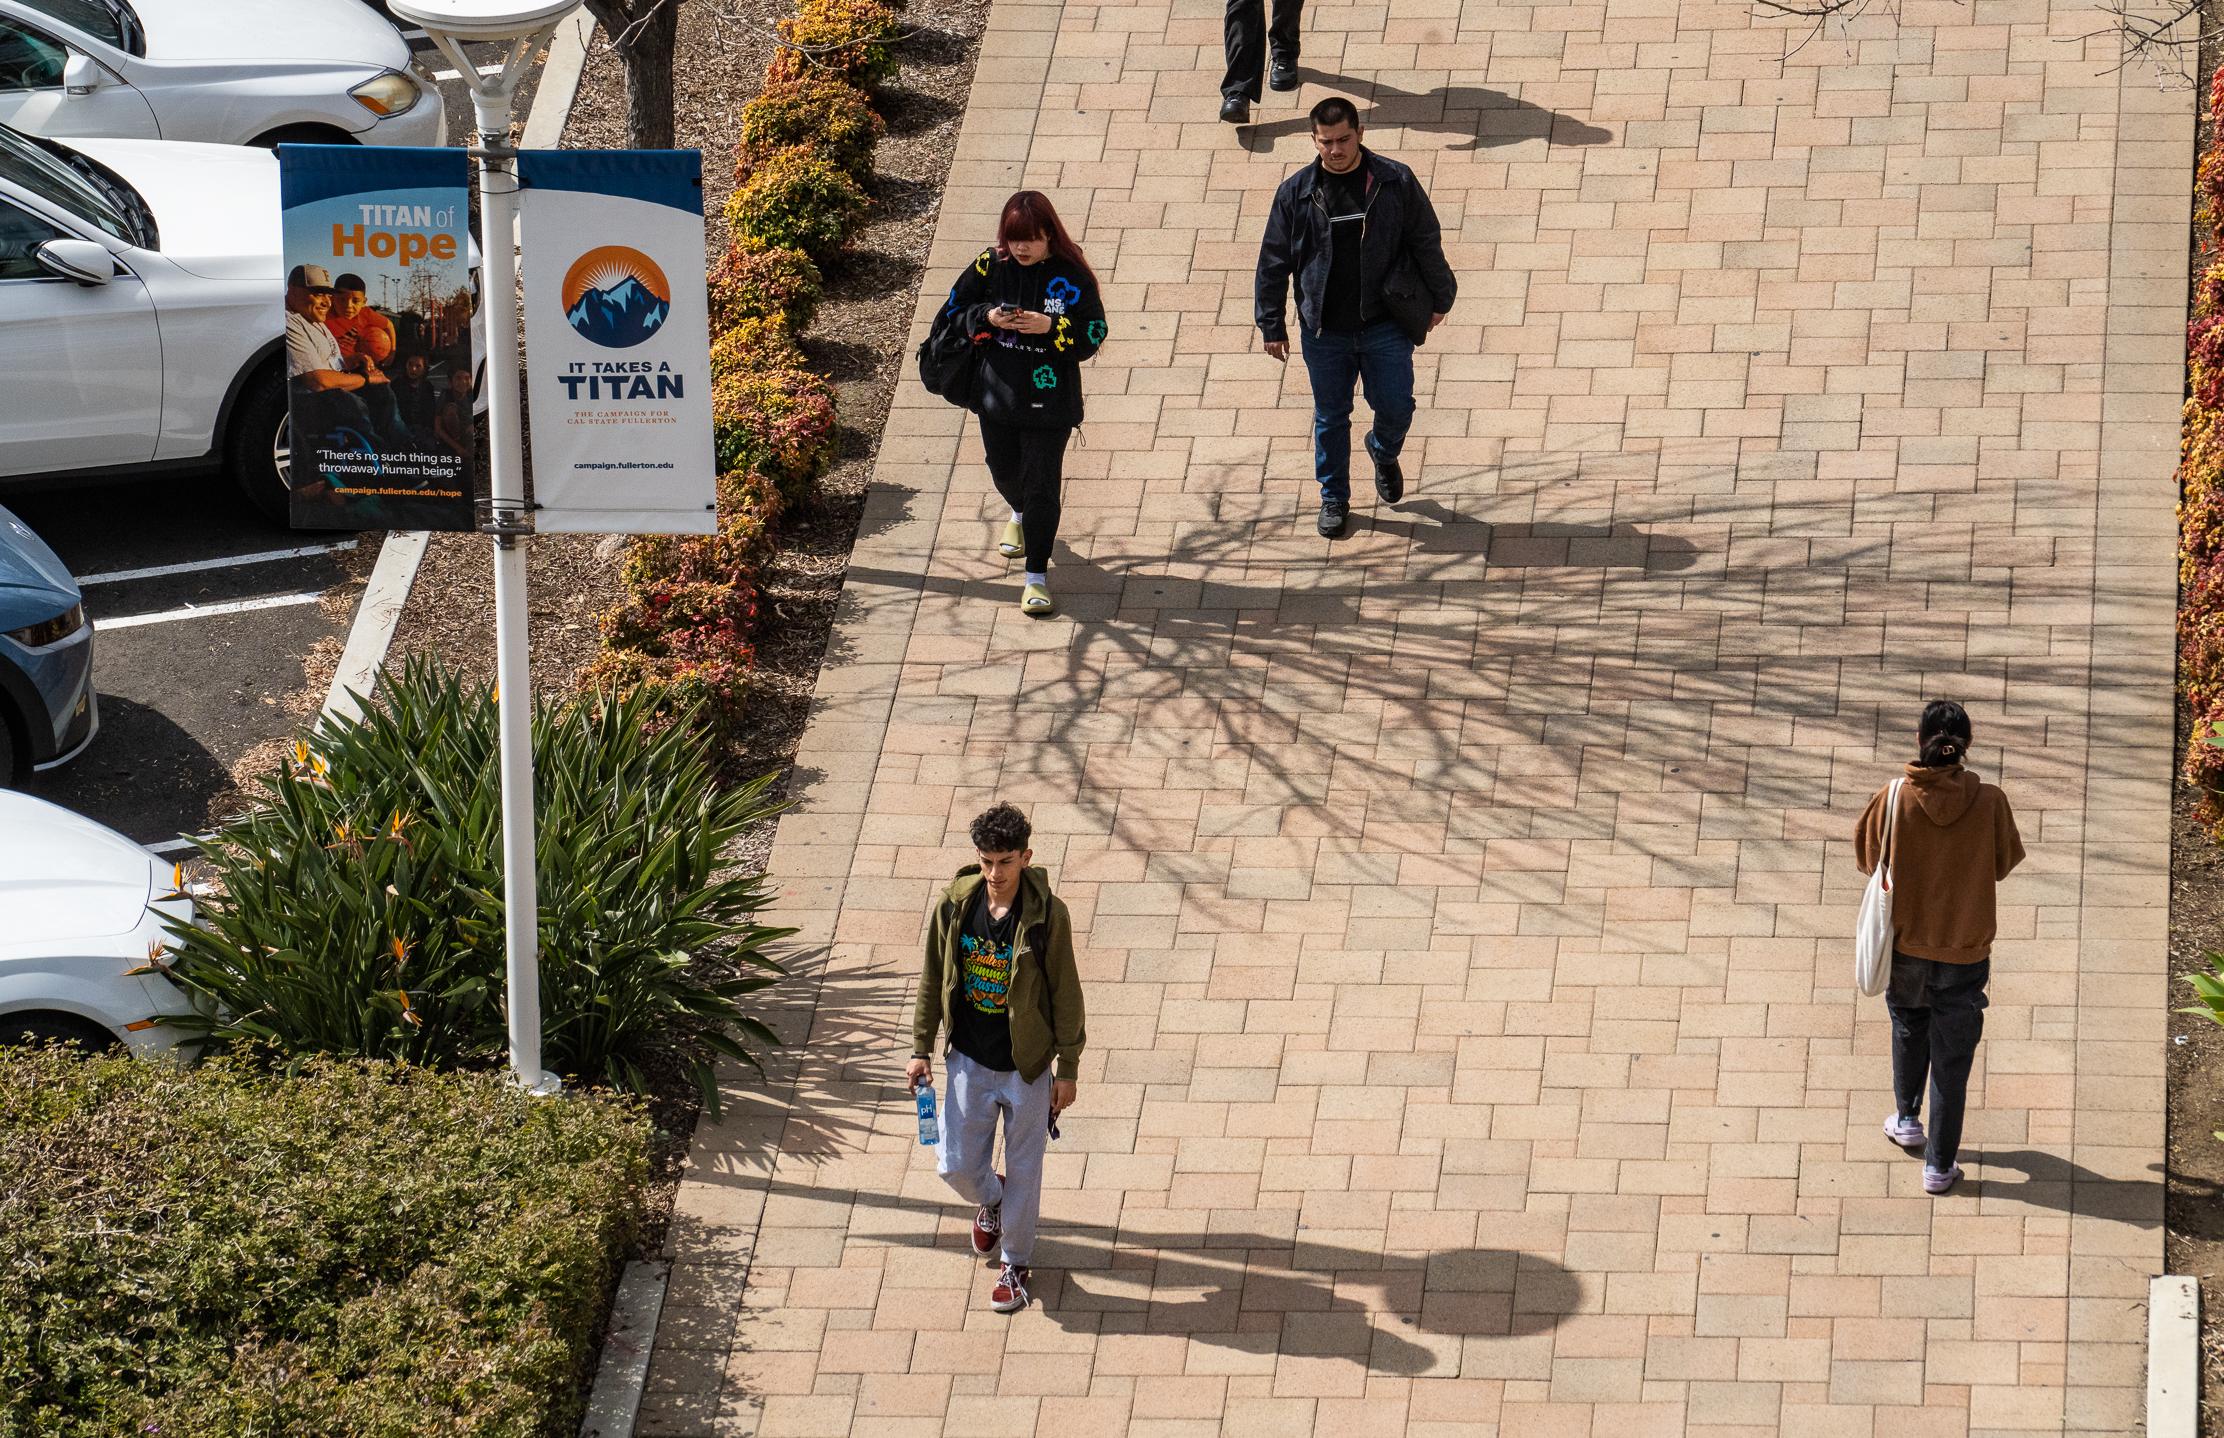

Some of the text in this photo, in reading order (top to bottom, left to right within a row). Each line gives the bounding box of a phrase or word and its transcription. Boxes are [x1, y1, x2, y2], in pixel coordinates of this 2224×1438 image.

[358, 204, 454, 228] TITAN of
[332, 223, 457, 267] Hope
[569, 361, 671, 373] IT TAKES A
[557, 375, 684, 400] TITAN
[597, 410, 647, 418] CAMPAIGN
[621, 417, 678, 425] FULLERTON
[364, 453, 379, 461] no
[380, 452, 407, 462] such
[409, 453, 438, 465] thing
[454, 456, 462, 464] a
[318, 462, 380, 475] throwaway
[382, 464, 420, 475] human
[574, 462, 674, 470] campaign.fullerton.edu
[334, 487, 462, 498] campaign.fullerton.edu/hope
[970, 950, 1009, 969] Endless
[969, 974, 1007, 994] Classic
[920, 1103, 933, 1116] pH
